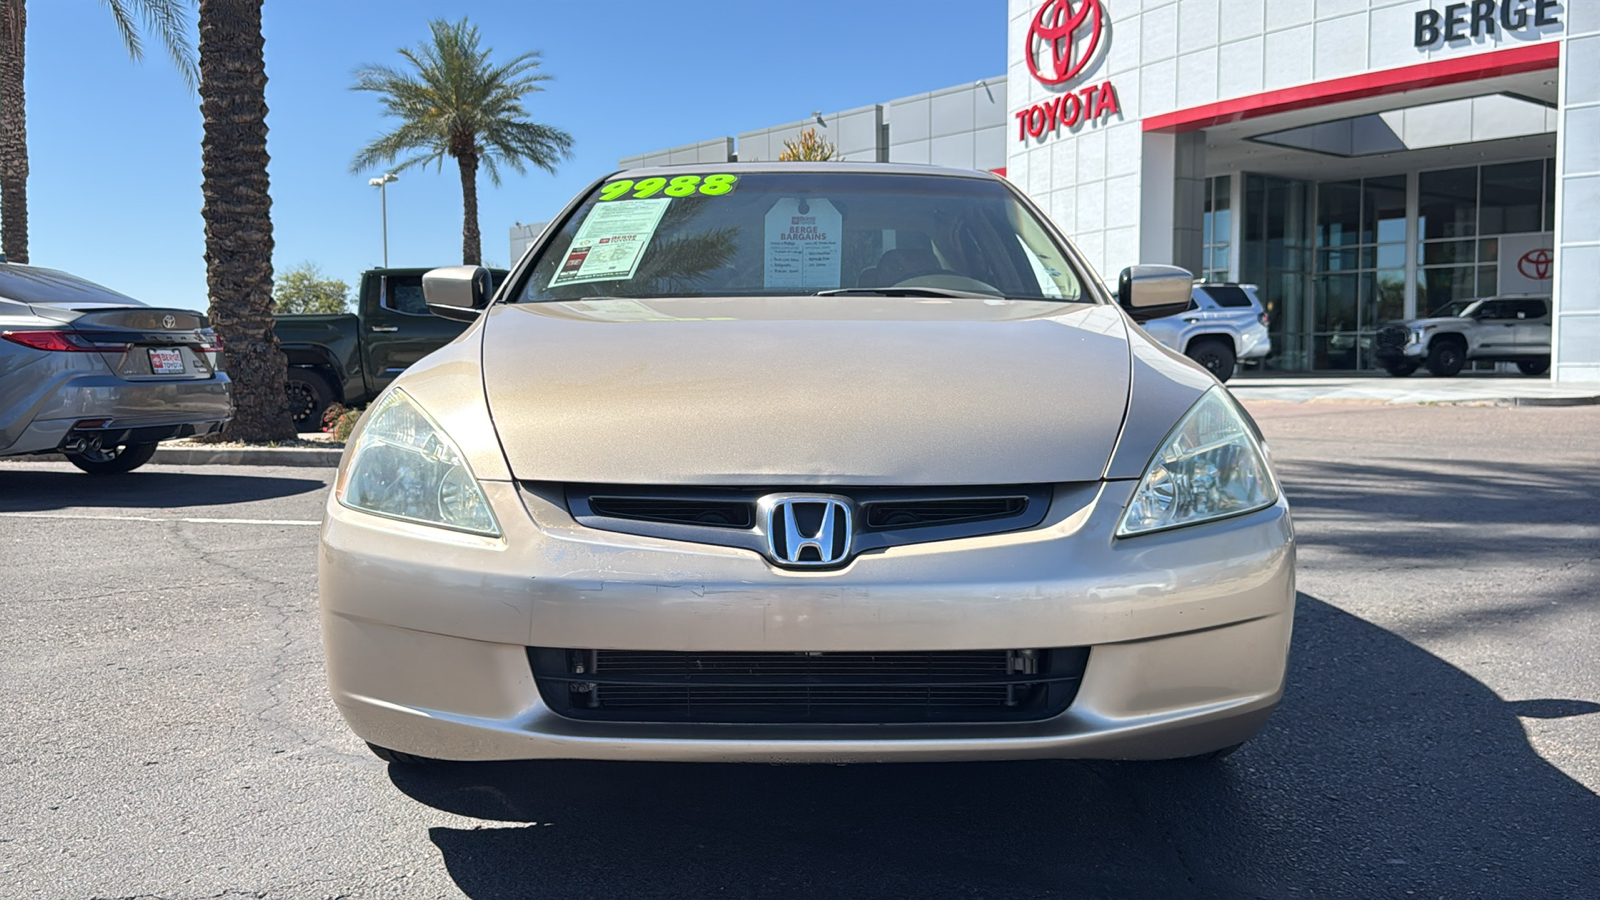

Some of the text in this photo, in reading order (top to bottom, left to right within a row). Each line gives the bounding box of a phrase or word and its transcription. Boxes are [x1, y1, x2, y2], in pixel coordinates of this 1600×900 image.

[1414, 0, 1559, 47] BERGE
[1015, 81, 1118, 142] TOYOTA
[598, 174, 738, 201] 9988
[161, 353, 181, 361] BERGE
